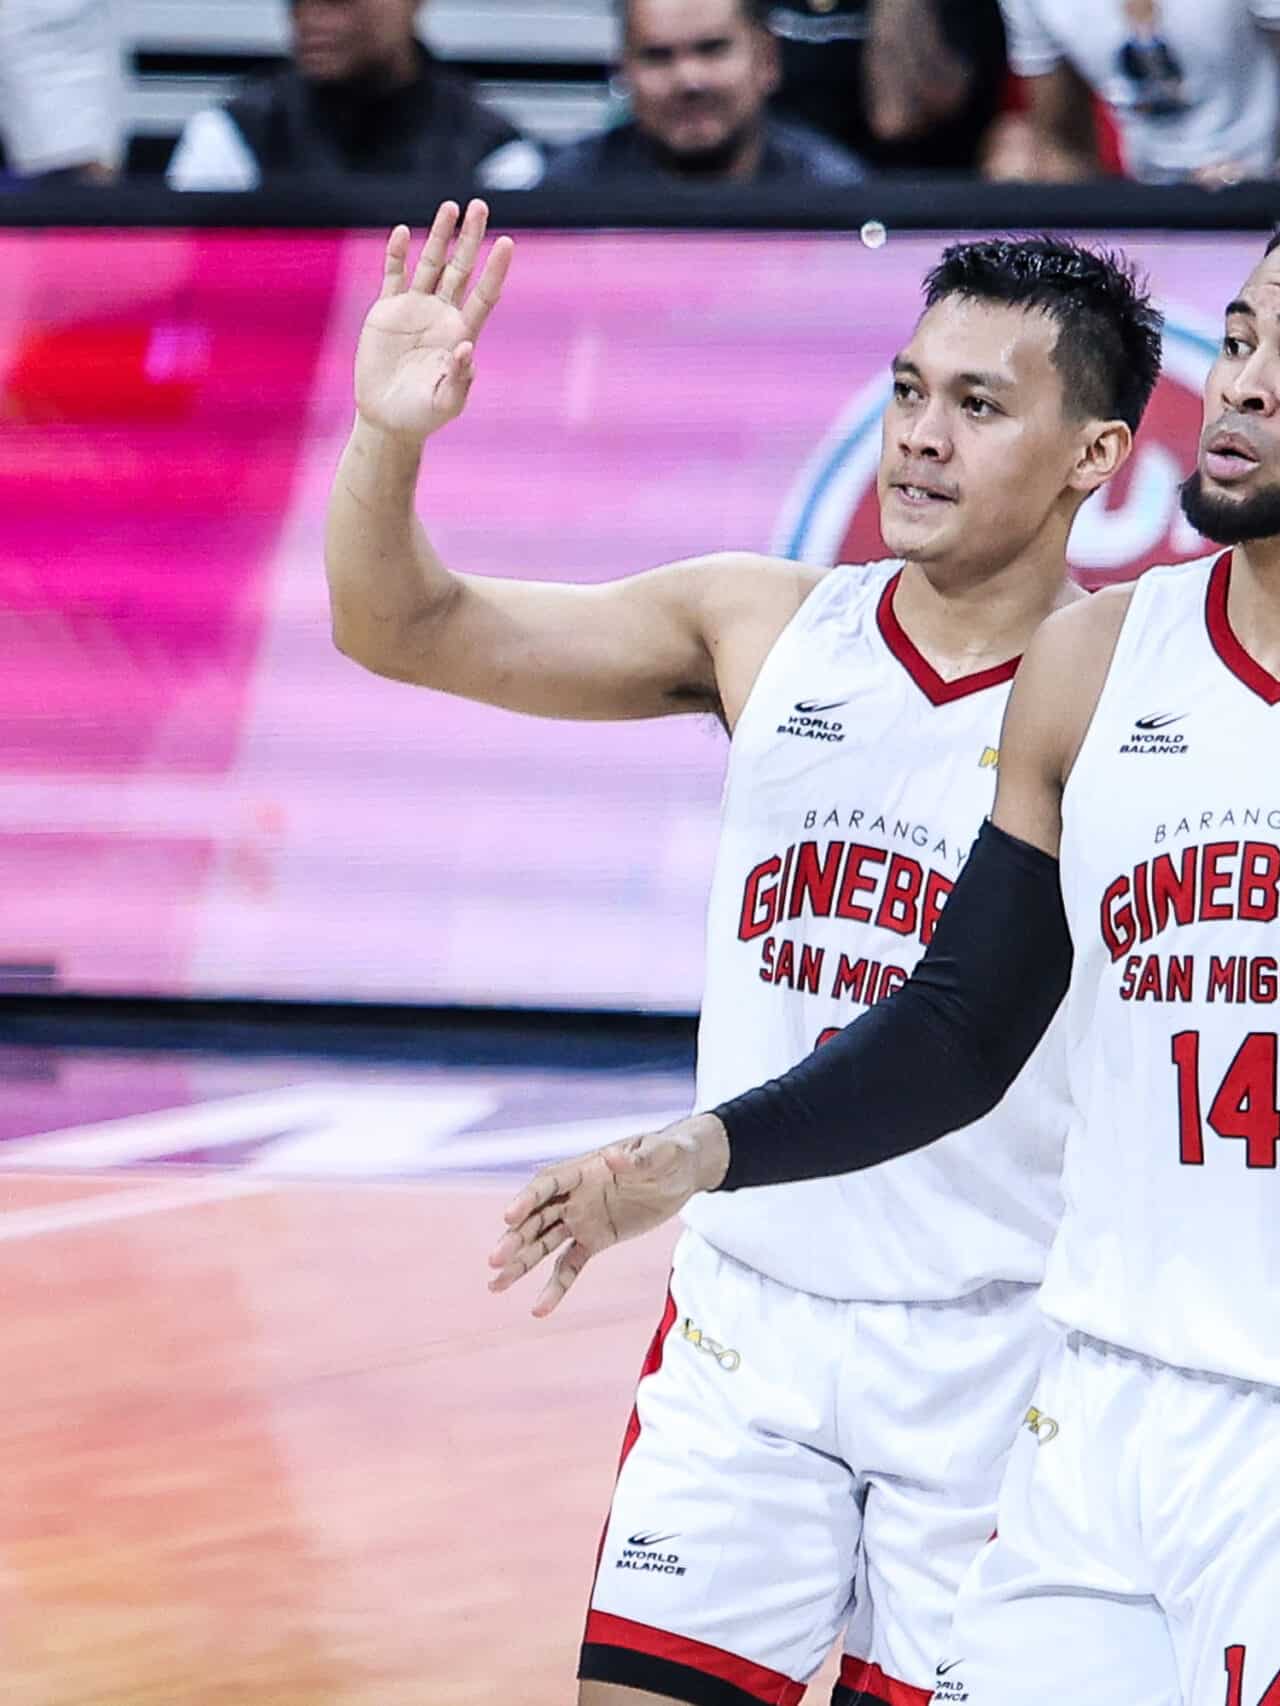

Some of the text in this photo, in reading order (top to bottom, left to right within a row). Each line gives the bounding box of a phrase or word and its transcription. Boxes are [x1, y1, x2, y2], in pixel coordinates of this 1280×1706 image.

[788, 715, 843, 732] WORLD
[776, 725, 846, 743] BALANCE
[1129, 733, 1184, 744] WORLD
[1118, 744, 1189, 755] BALANCE
[803, 808, 967, 868] BARANGAY
[759, 936, 909, 1006] SAN MIG
[1119, 954, 1195, 1002] SAN
[622, 1549, 679, 1564] WORLD
[615, 1559, 687, 1577] BALANCE
